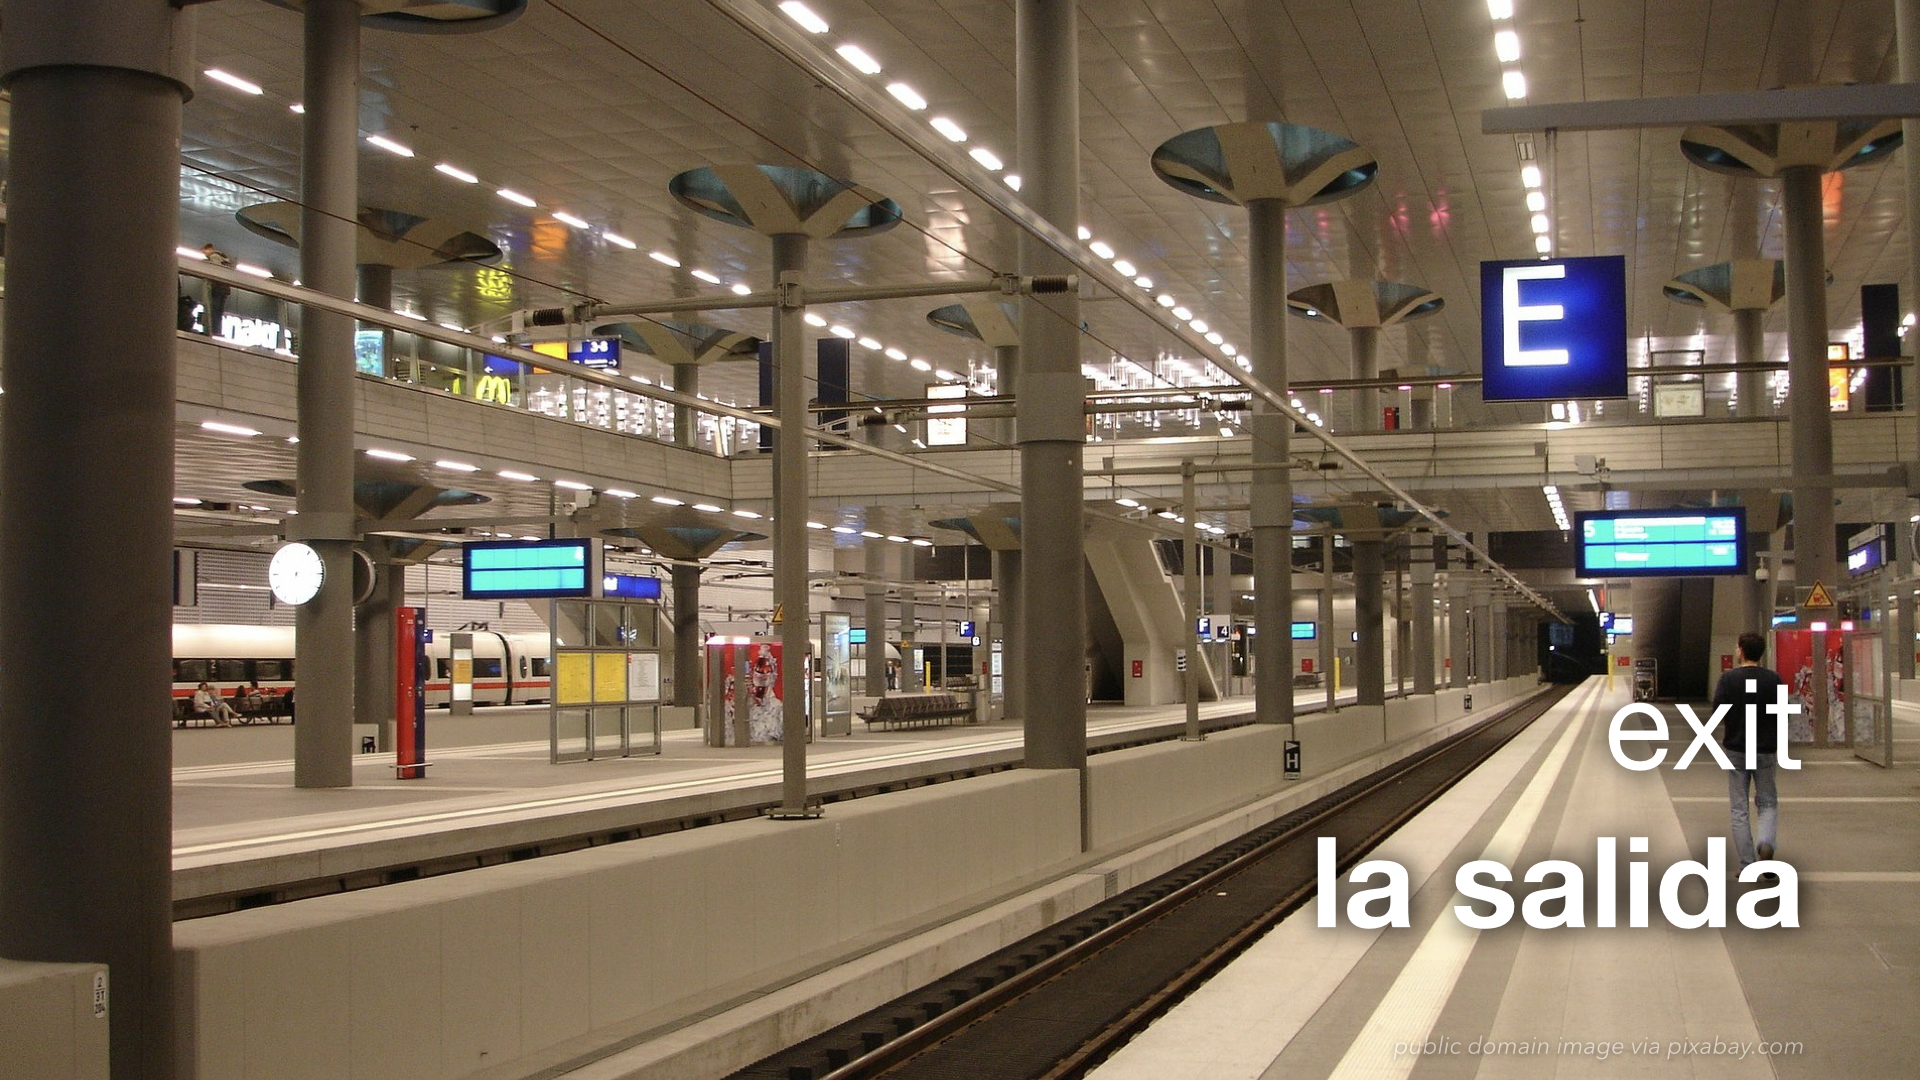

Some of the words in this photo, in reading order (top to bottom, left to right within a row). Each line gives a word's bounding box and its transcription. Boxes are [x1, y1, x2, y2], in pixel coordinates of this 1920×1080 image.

[1503, 265, 1569, 366] E
[1584, 520, 1595, 538] 5
[960, 621, 970, 635] F
[1199, 618, 1208, 632] F
[1599, 612, 1609, 628] F
[1221, 626, 1228, 636] 4
[1286, 753, 1298, 769] H
